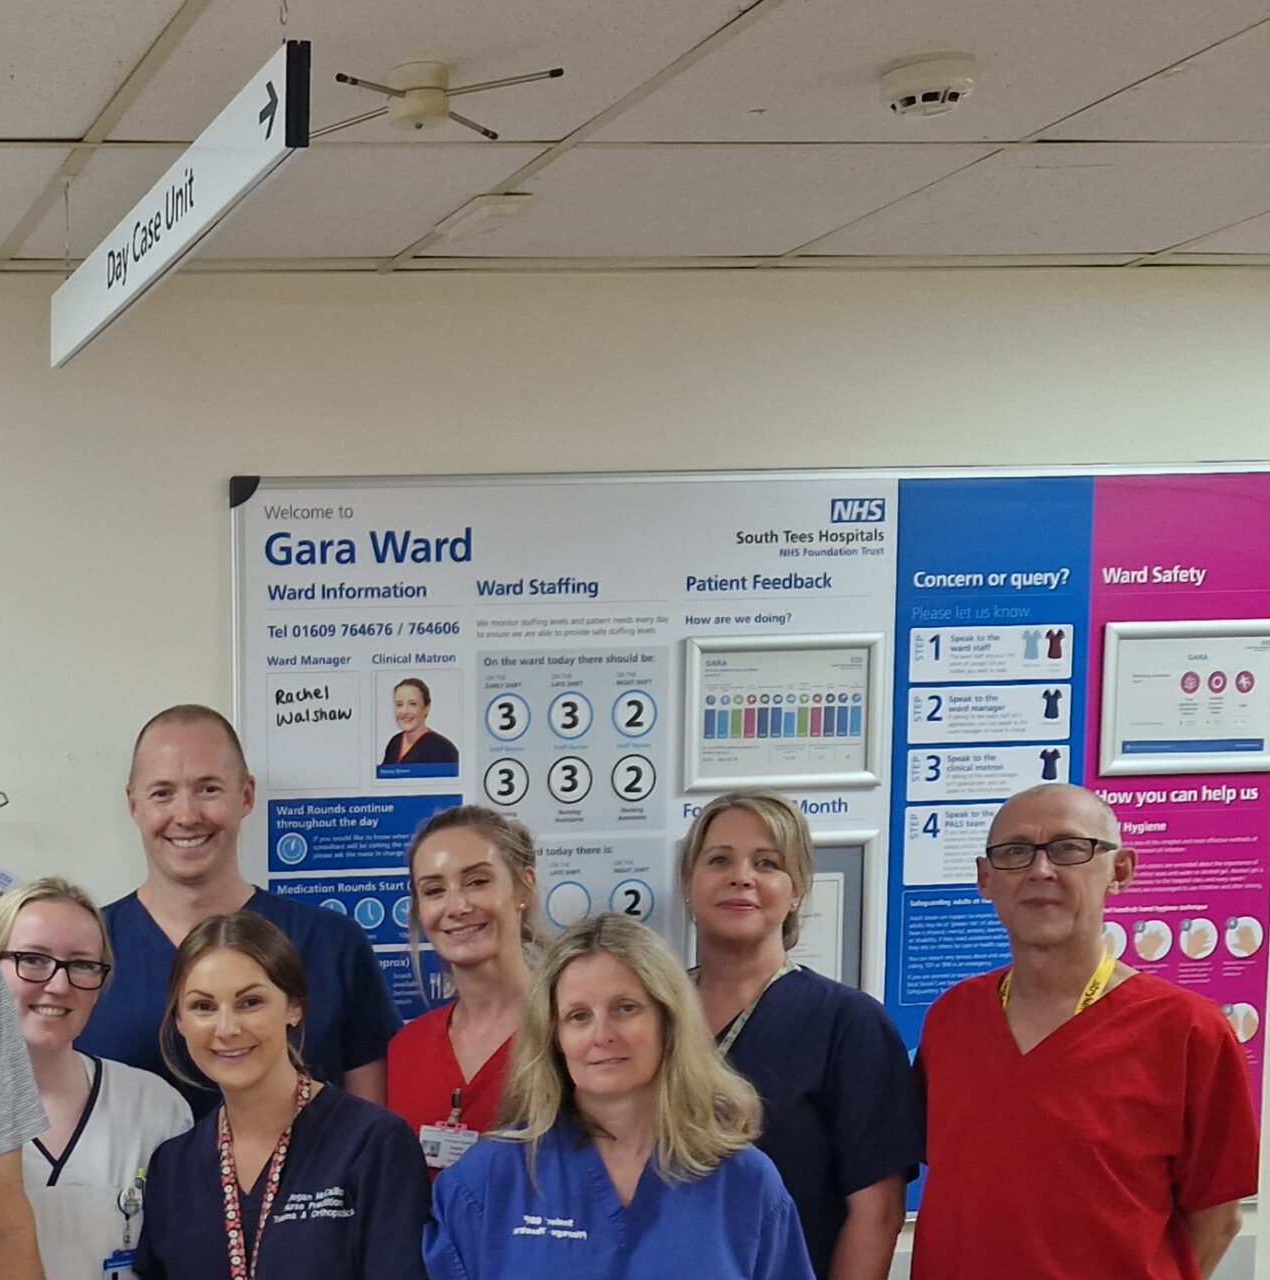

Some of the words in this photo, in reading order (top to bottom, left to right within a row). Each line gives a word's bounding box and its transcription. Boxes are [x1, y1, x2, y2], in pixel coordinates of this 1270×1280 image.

[106, 243, 130, 289] Day
[132, 211, 163, 262] Case
[165, 168, 195, 231] Unit
[264, 505, 334, 520] Welcome
[338, 505, 354, 519] to
[832, 500, 884, 522] NHS
[265, 531, 357, 566] Gara
[369, 527, 473, 564] Ward
[736, 530, 779, 545] South
[783, 530, 814, 543] Tees
[819, 528, 885, 546] Hospitals
[779, 548, 801, 557] NHS
[803, 547, 858, 557] Foundation
[861, 546, 885, 556] Trust
[686, 574, 748, 591] Patient
[753, 572, 833, 590] Feedback
[913, 571, 984, 588] Concern
[987, 572, 1007, 587] or
[1010, 568, 1071, 590] query?
[1102, 566, 1148, 584] Ward
[1152, 565, 1207, 586] Safety
[267, 583, 315, 601] Ward
[321, 581, 428, 600] Information
[476, 579, 523, 596] Ward
[529, 577, 599, 598] Staffing
[685, 614, 711, 625] How
[714, 615, 731, 625] are
[734, 614, 751, 624] we
[754, 612, 792, 625] doing?
[912, 606, 952, 620] Please
[955, 605, 972, 619] let
[976, 607, 990, 619] us
[994, 604, 1032, 618] know.
[268, 625, 288, 638] Tel
[292, 624, 336, 638] 01609
[341, 622, 393, 637] 764676
[408, 621, 460, 635] 764606
[929, 634, 941, 661] 1
[267, 654, 297, 667] Ward
[300, 654, 352, 668] Manager
[371, 653, 412, 665] Clinical
[415, 652, 456, 664] Matron
[484, 657, 498, 667] On
[501, 656, 517, 667] the
[519, 655, 545, 666] ward
[547, 655, 575, 667] today
[578, 654, 603, 664] there
[606, 653, 638, 664] should
[641, 653, 656, 663] be:
[275, 685, 330, 705] Rachel
[276, 708, 353, 727] Walshaw
[497, 702, 517, 731] 3
[560, 701, 579, 730] 3
[624, 699, 644, 728] 2
[926, 695, 943, 722] 2
[925, 755, 942, 782] 3
[496, 768, 515, 796] 3
[559, 765, 578, 793] 3
[623, 765, 643, 793] 2
[1095, 788, 1134, 804] How
[1135, 790, 1167, 808] you
[1170, 790, 1198, 803] can
[1202, 785, 1237, 805] help
[1241, 786, 1259, 800] us
[276, 804, 305, 816] Ward
[307, 803, 346, 815] Rounds
[348, 802, 394, 814] continue
[276, 816, 337, 831] throughout
[339, 816, 357, 828] the
[360, 816, 379, 829] day
[922, 812, 940, 839] 4
[1123, 821, 1167, 835] Hygiene
[546, 847, 573, 857] today
[576, 846, 601, 855] there
[604, 845, 615, 854] is:
[277, 883, 335, 895] Medication
[337, 882, 377, 893] Rounds
[379, 881, 405, 891] Start
[624, 889, 641, 916] 2
